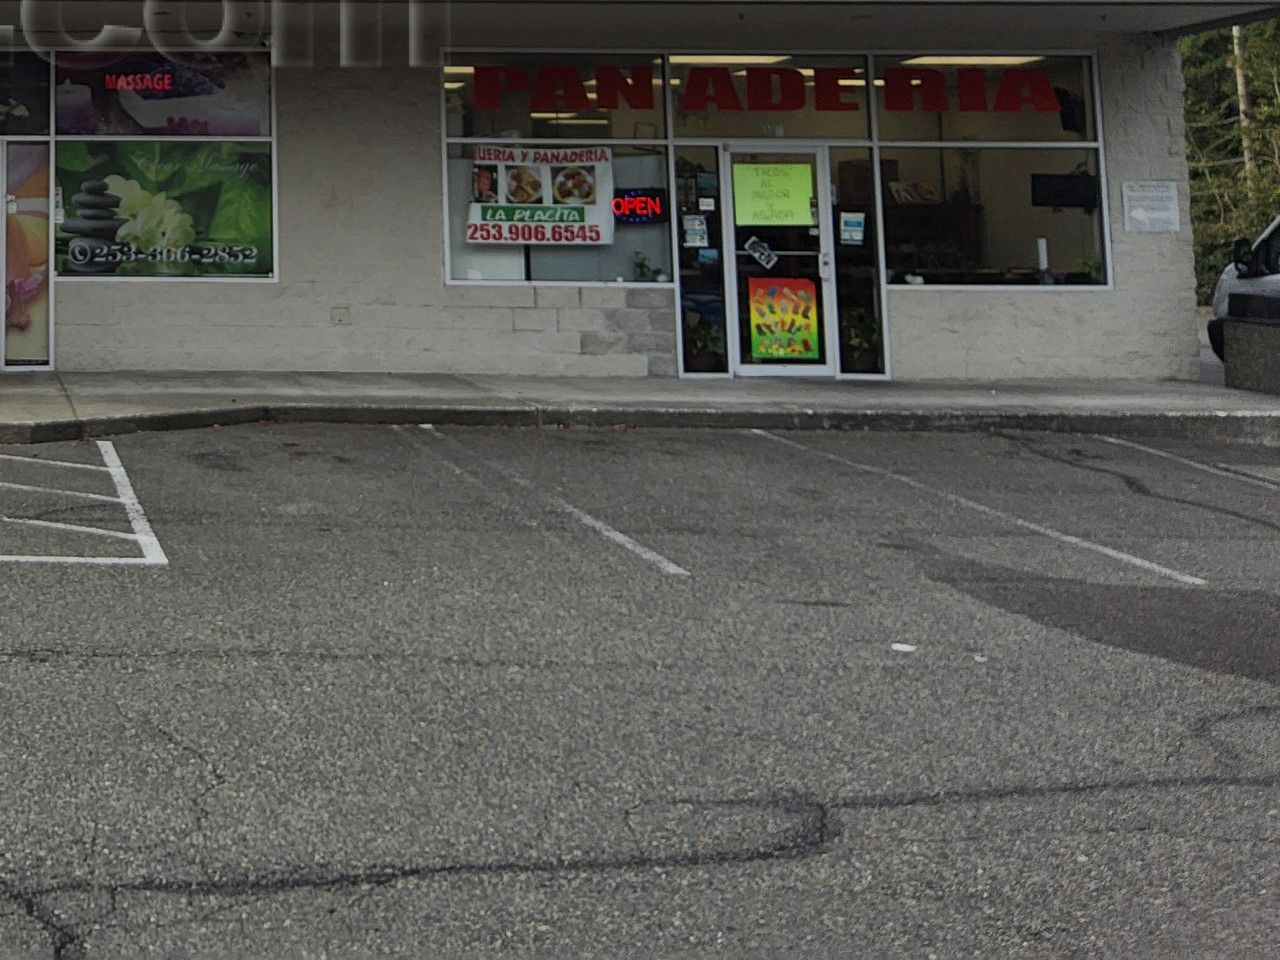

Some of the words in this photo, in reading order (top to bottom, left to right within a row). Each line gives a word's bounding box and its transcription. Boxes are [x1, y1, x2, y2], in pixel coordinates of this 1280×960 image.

[104, 73, 173, 91] MASSAGE
[473, 66, 1060, 113] PANADERIA
[474, 147, 515, 161] UERIA
[532, 148, 608, 163] PANADERIA
[485, 208, 507, 221] LA
[610, 196, 662, 216] OPEN
[467, 223, 602, 242] 253.906.6545
